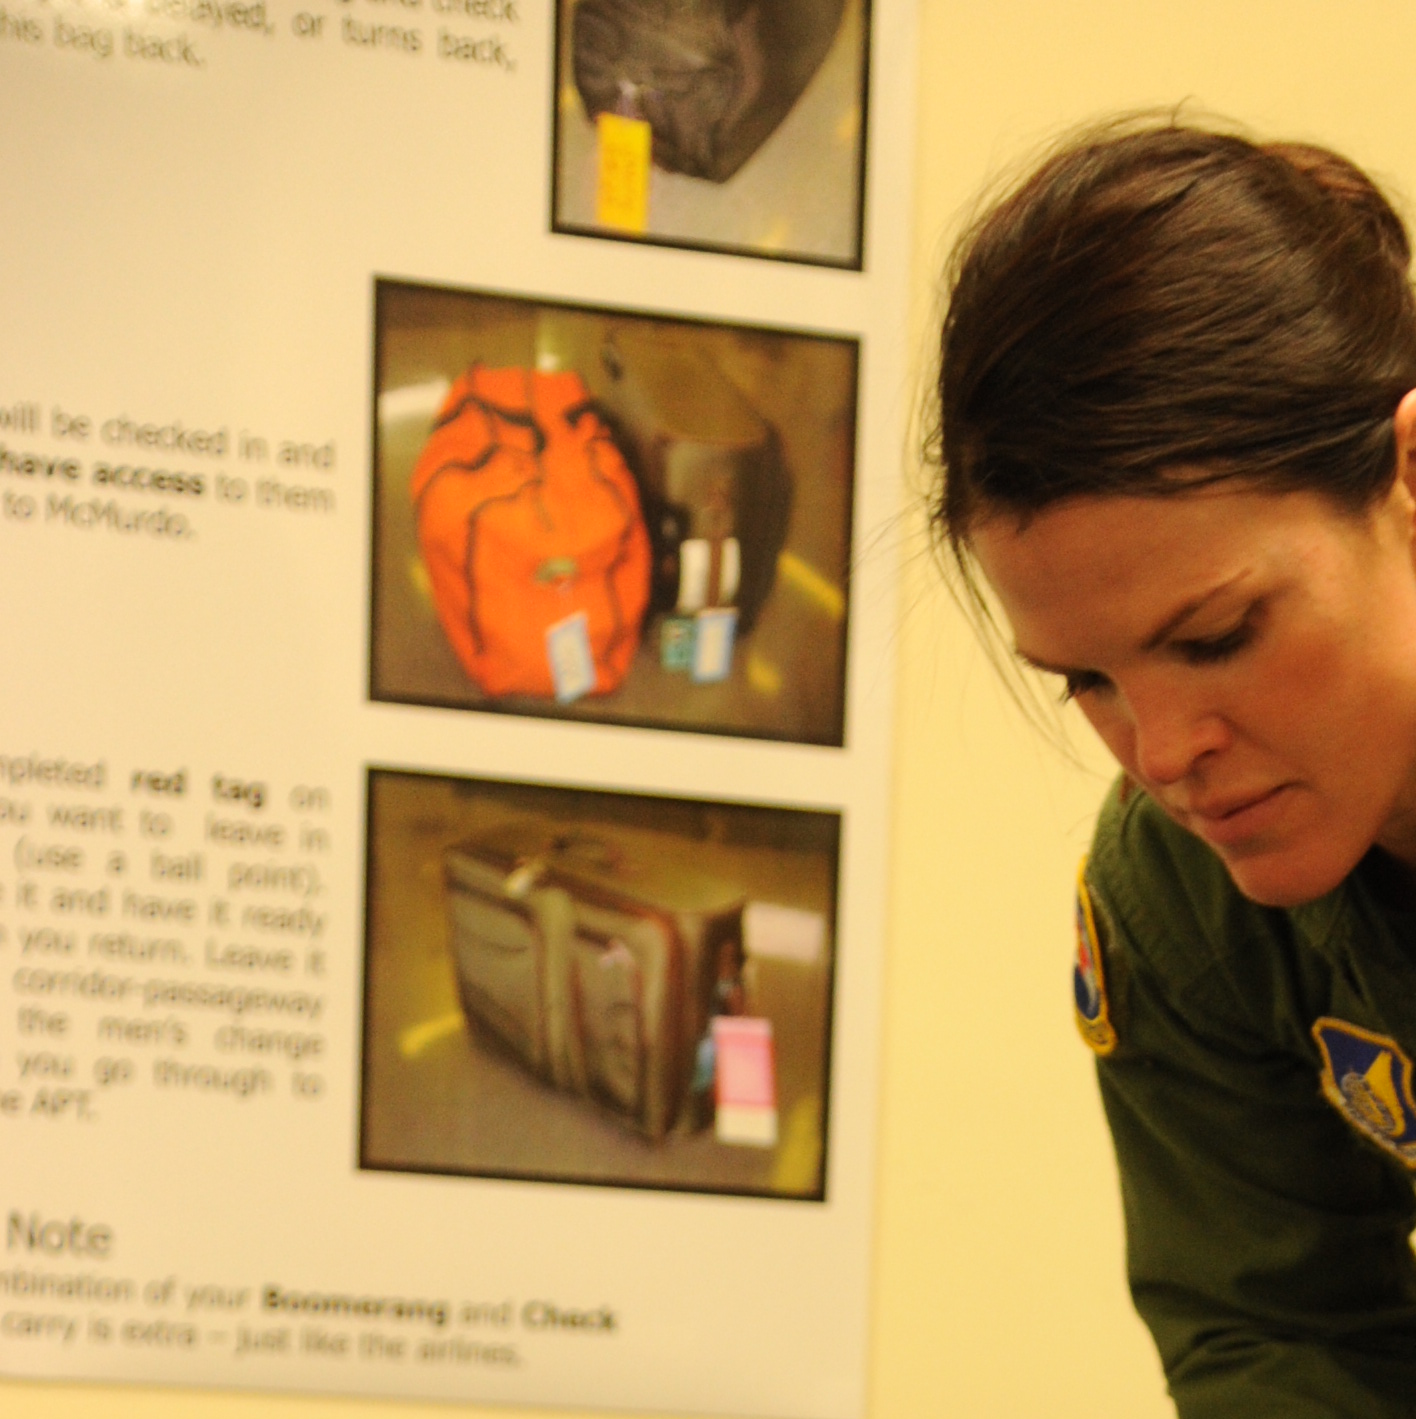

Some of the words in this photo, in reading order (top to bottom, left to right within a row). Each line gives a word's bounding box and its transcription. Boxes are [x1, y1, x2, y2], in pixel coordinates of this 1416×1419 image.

[53, 16, 113, 60] bag
[292, 11, 323, 38] or
[341, 16, 422, 52] turns
[51, 404, 91, 440] be
[100, 413, 229, 456] checked
[238, 430, 268, 461] in
[276, 440, 336, 472] and
[0, 444, 82, 484] have
[91, 462, 204, 497] access
[214, 473, 249, 505] to
[255, 478, 335, 514] them
[3, 489, 36, 521] to
[45, 492, 196, 538] McMurdo.
[0, 752, 106, 790] pleted
[130, 766, 188, 796] red
[211, 772, 267, 815] tag
[287, 785, 331, 815] on
[47, 803, 123, 834] want
[139, 808, 174, 840] to
[205, 812, 287, 846] leave
[299, 821, 331, 851] in
[15, 834, 83, 873] (use
[106, 850, 127, 876] a
[150, 848, 205, 883] ball
[51, 885, 112, 918] and
[122, 887, 197, 924] have
[208, 895, 229, 926] it
[241, 904, 324, 940] ready
[18, 927, 75, 957] you
[204, 936, 294, 976] Leave
[18, 1004, 69, 1037] the
[213, 1022, 325, 1064] change
[16, 1050, 76, 1084] you
[93, 1055, 134, 1089] go
[153, 1057, 275, 1098] through
[291, 1071, 326, 1102] to
[7, 1209, 113, 1258] Note
[144, 1275, 177, 1306] of
[184, 1284, 249, 1314] your
[262, 1283, 448, 1332] Boomerang
[459, 1300, 511, 1328] and
[520, 1300, 620, 1336] Check
[2, 1311, 77, 1348] carry
[87, 1315, 112, 1344] is
[120, 1318, 197, 1349] extra
[234, 1326, 291, 1359] just
[302, 1326, 347, 1358] like
[359, 1330, 406, 1364] the
